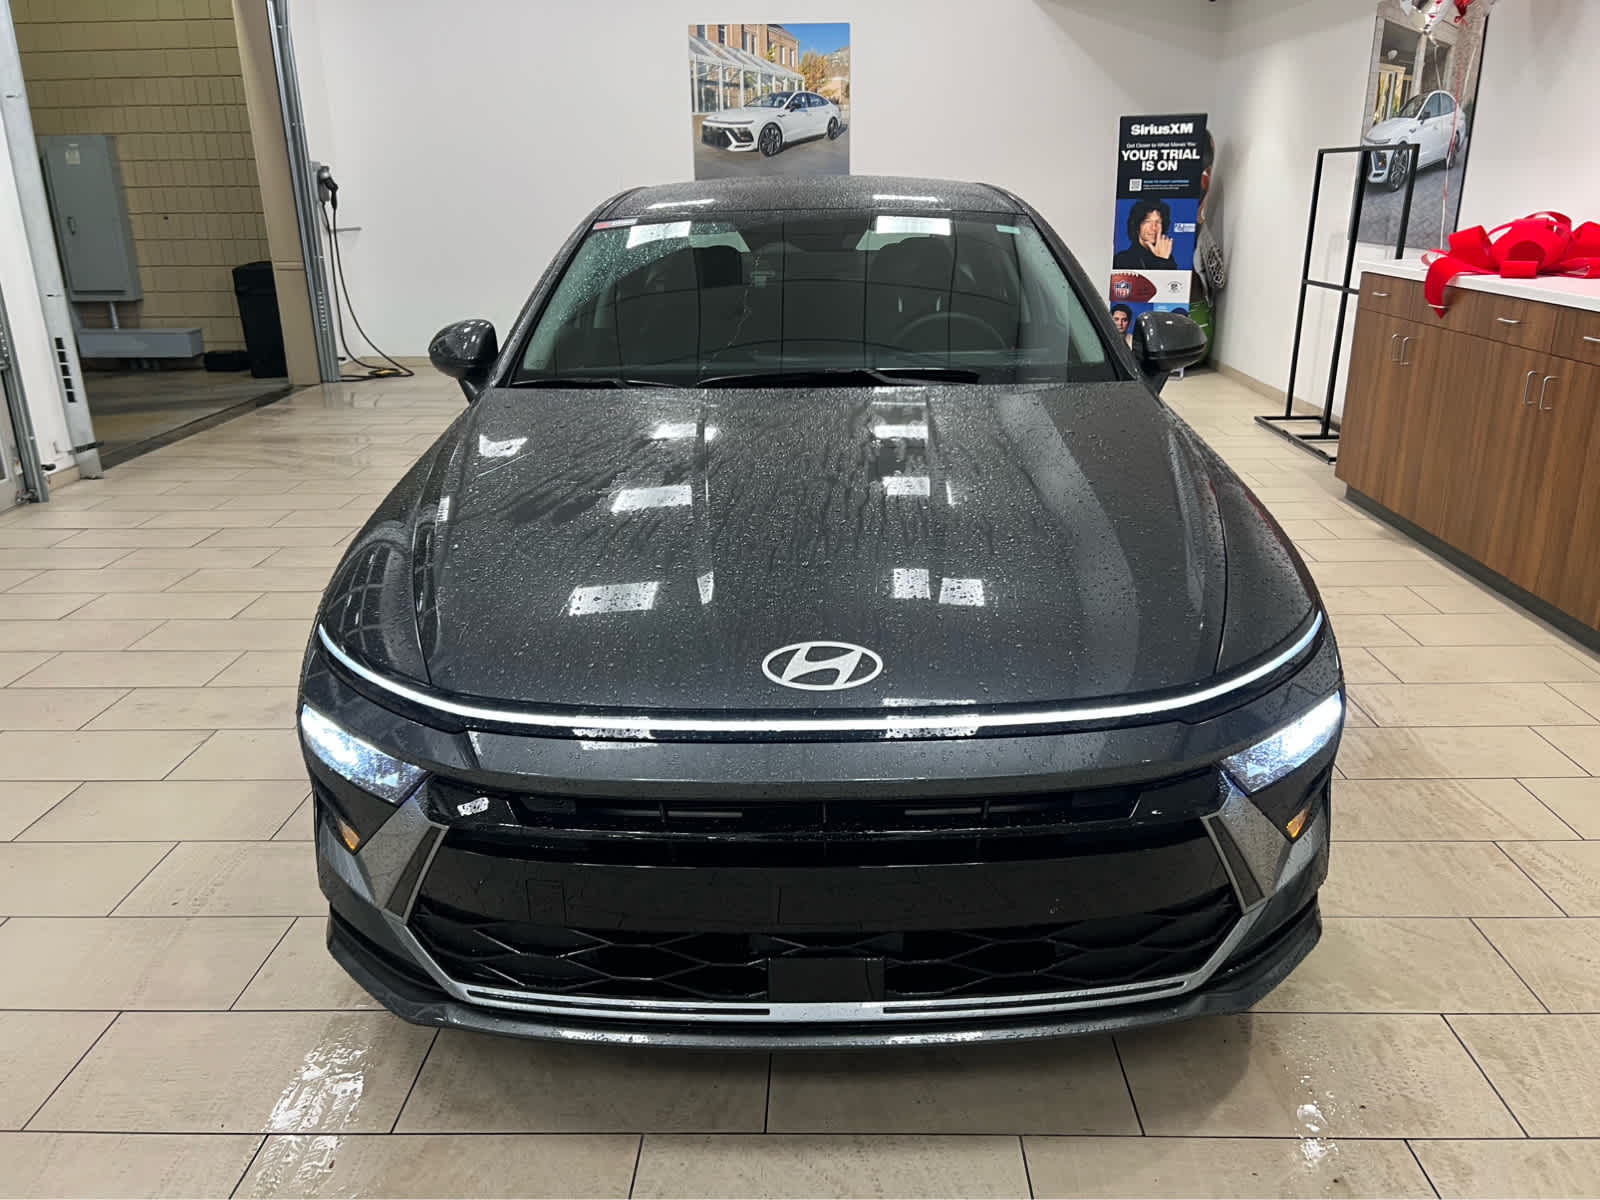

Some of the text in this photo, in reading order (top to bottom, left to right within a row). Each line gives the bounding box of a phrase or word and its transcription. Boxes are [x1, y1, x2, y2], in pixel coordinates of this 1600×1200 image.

[1130, 122, 1194, 136] SiriusXM
[1121, 148, 1201, 161] YOUR TRIAL
[1141, 160, 1178, 172] IS ON
